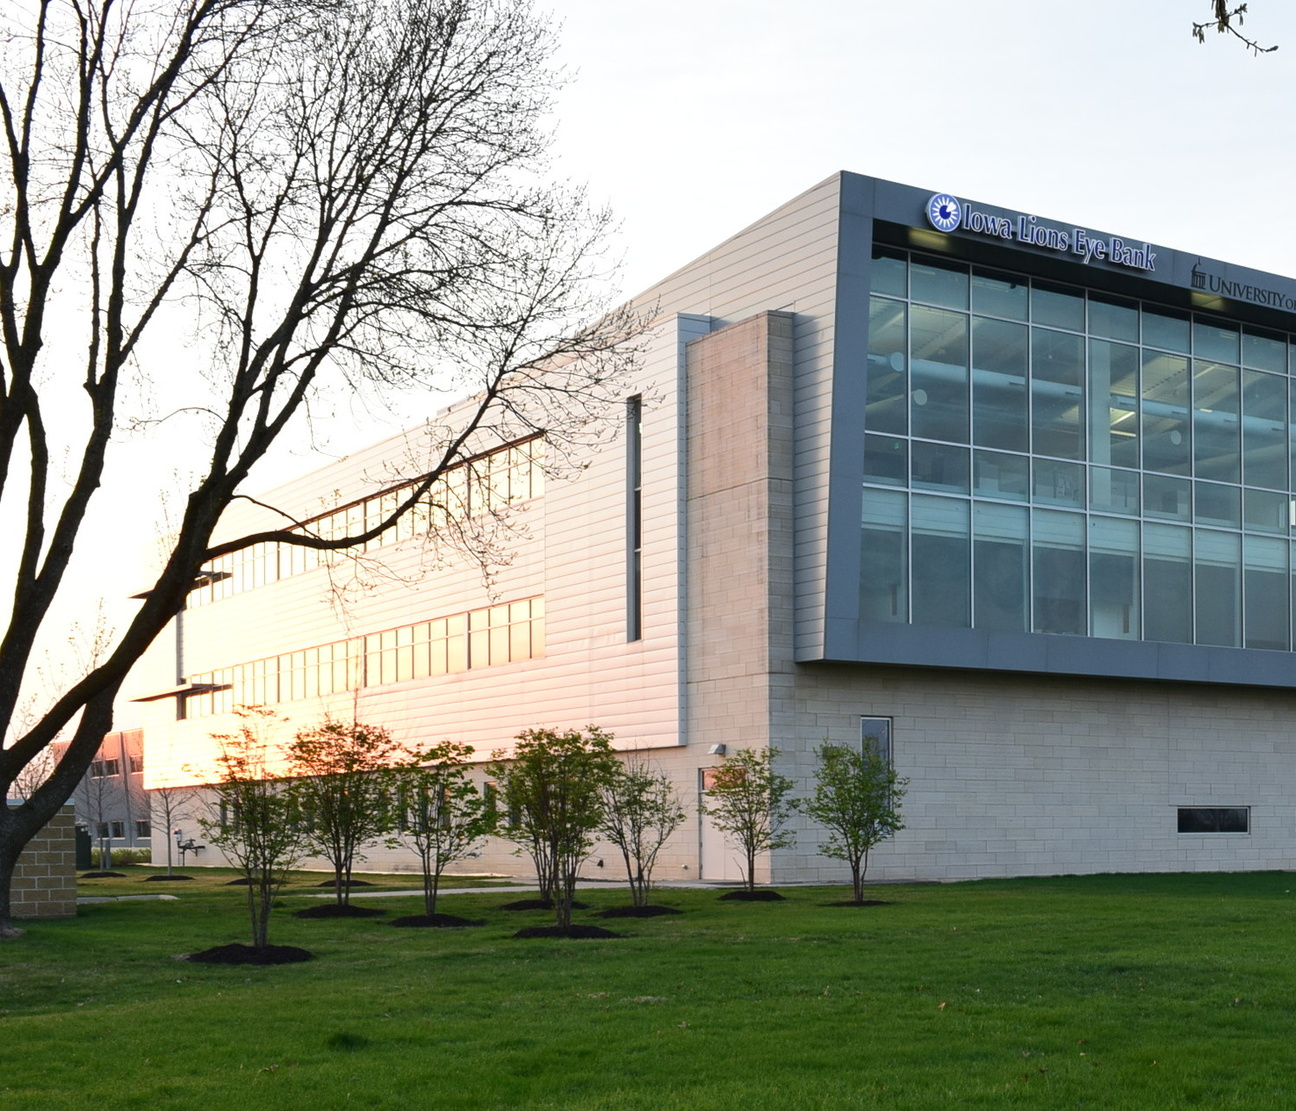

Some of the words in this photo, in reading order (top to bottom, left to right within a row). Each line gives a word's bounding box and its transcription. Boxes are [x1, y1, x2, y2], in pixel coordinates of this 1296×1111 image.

[962, 203, 1012, 239] Iowa
[1017, 214, 1069, 251] Lions
[1072, 228, 1106, 264] Eye
[1108, 237, 1156, 272] Bank
[1209, 276, 1286, 307] UNIVERSITY
